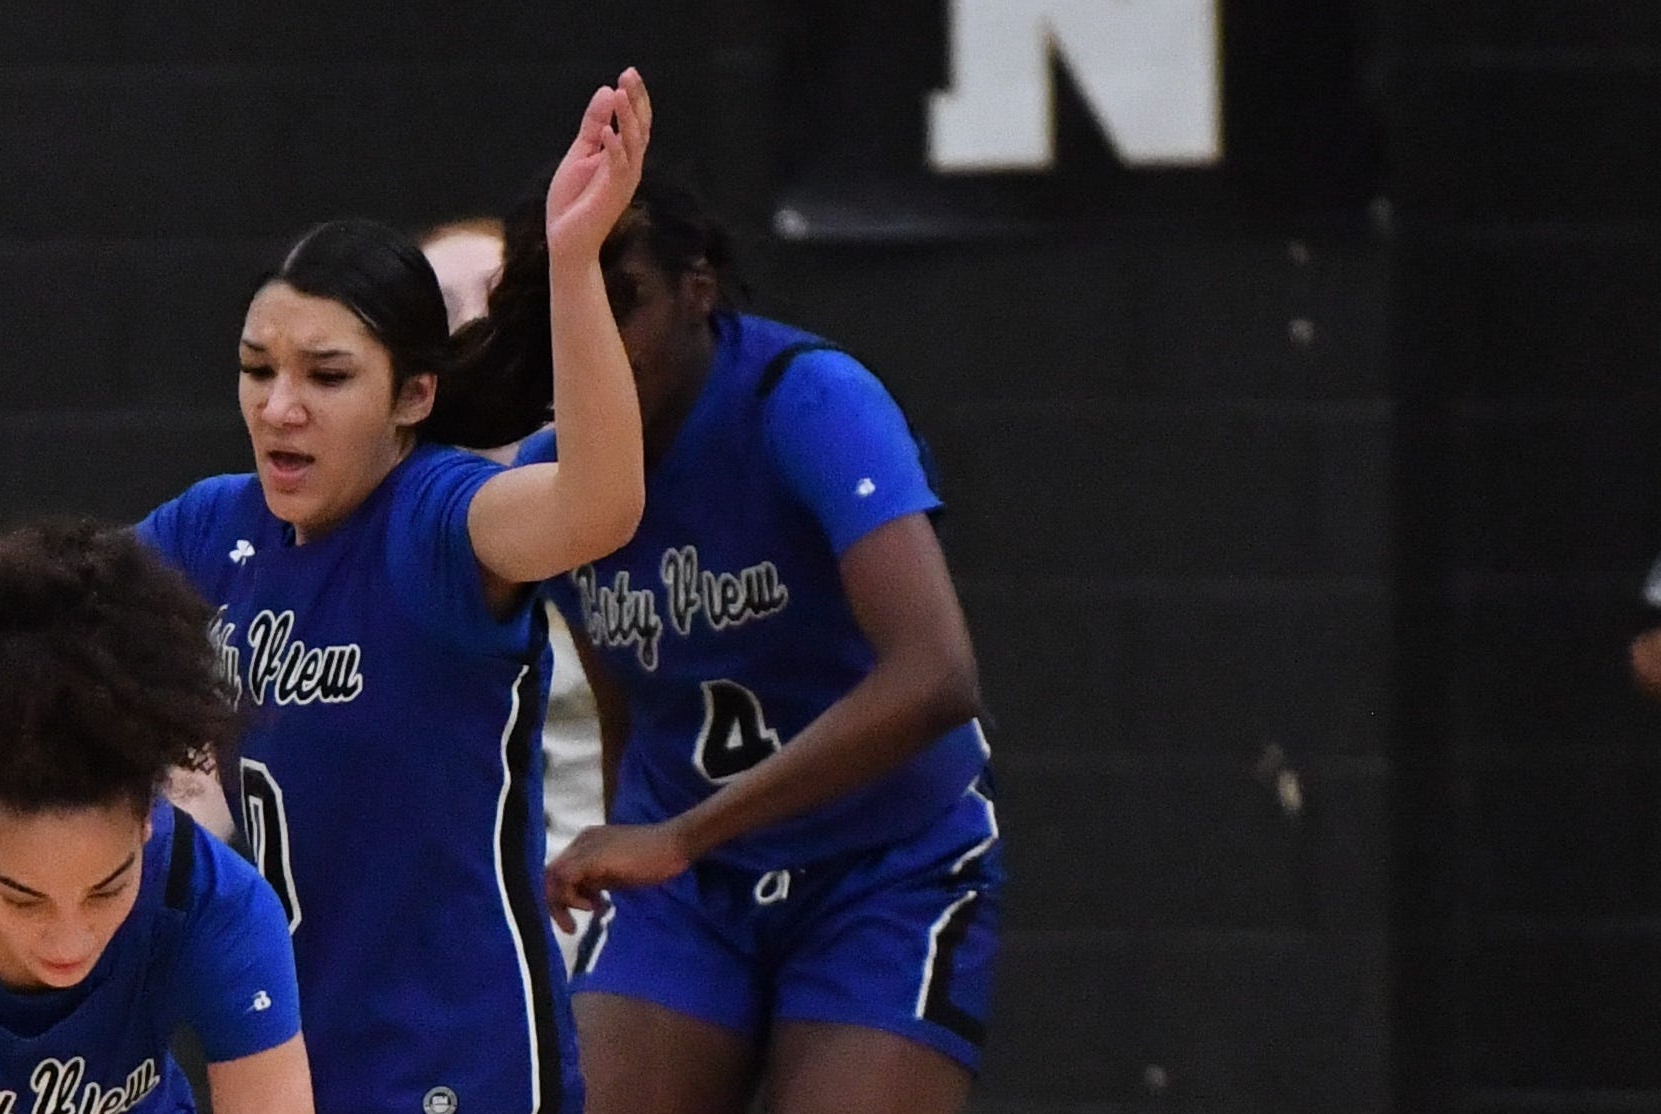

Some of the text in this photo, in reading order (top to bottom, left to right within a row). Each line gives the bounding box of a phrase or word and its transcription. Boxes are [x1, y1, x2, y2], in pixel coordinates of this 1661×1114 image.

[662, 545, 788, 637] View
[248, 609, 363, 705] View
[692, 678, 782, 784] 4
